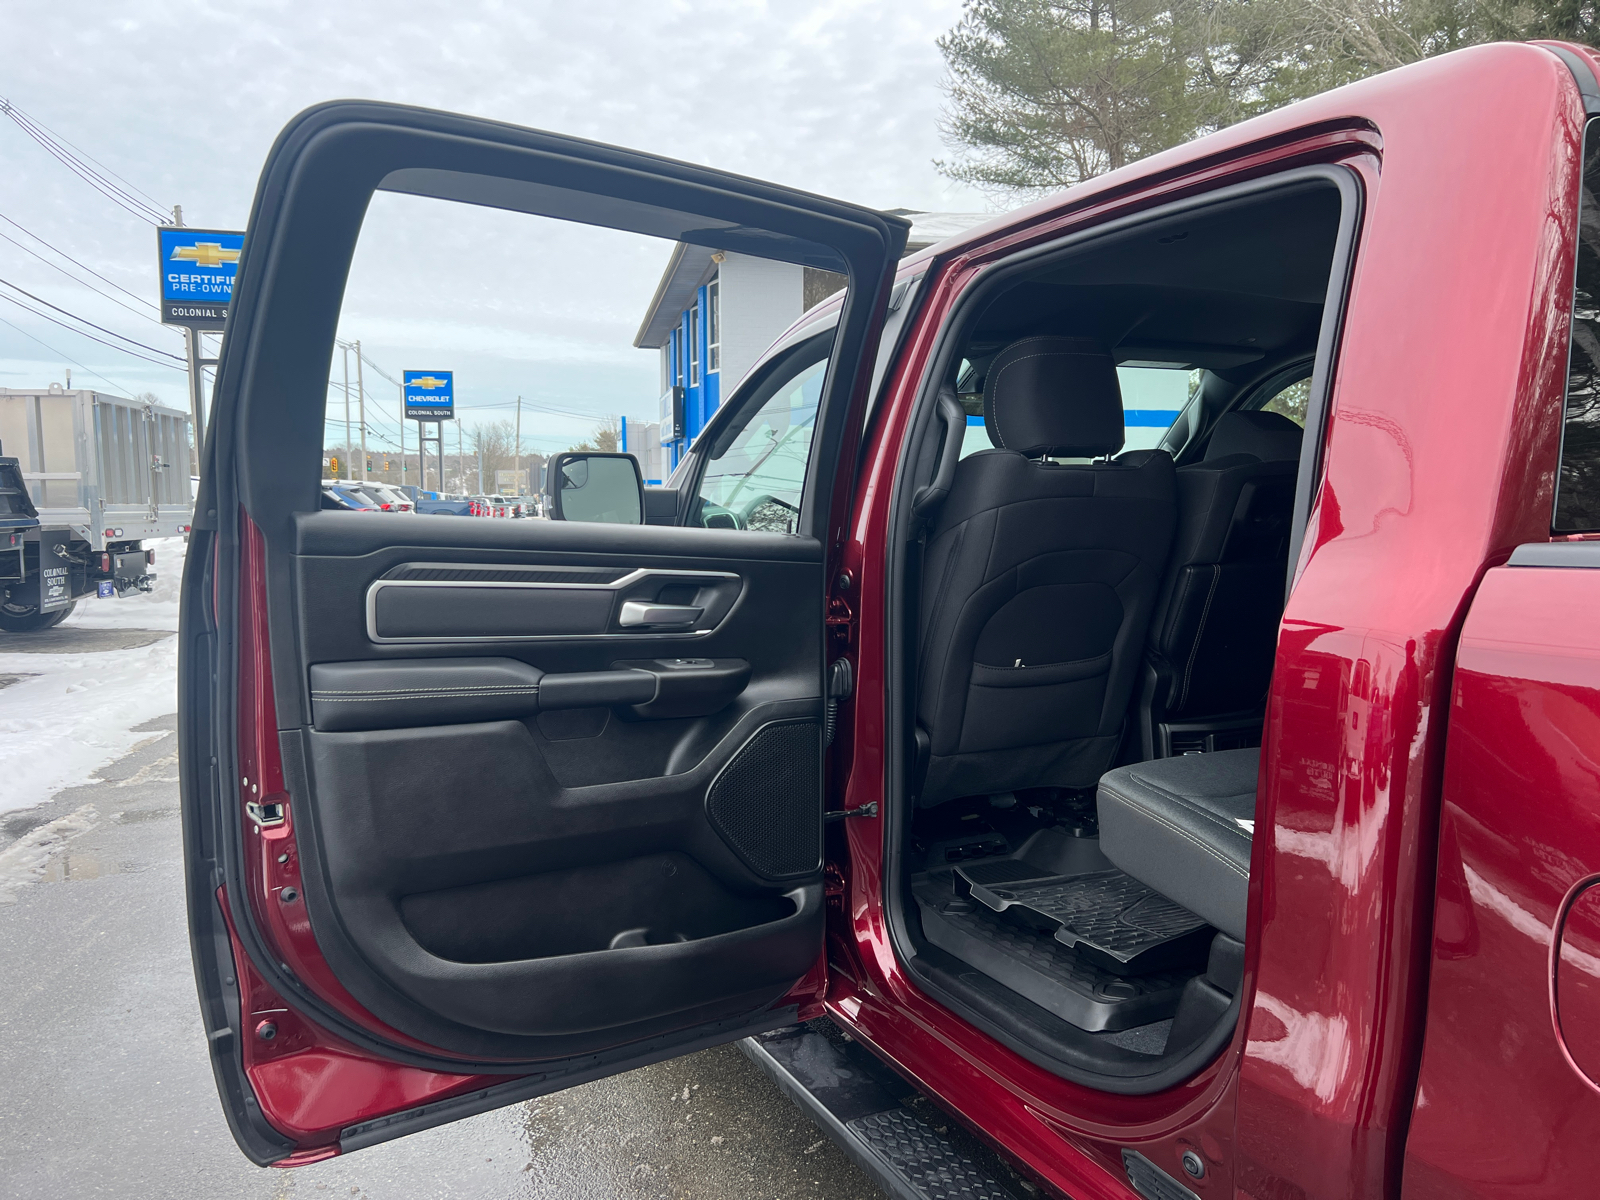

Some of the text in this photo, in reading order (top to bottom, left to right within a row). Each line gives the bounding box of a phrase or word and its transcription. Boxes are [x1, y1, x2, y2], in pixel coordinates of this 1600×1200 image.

[172, 308, 217, 317] COLONIAL
[43, 567, 69, 578] COLONIAL
[46, 576, 65, 587] SOUTH
